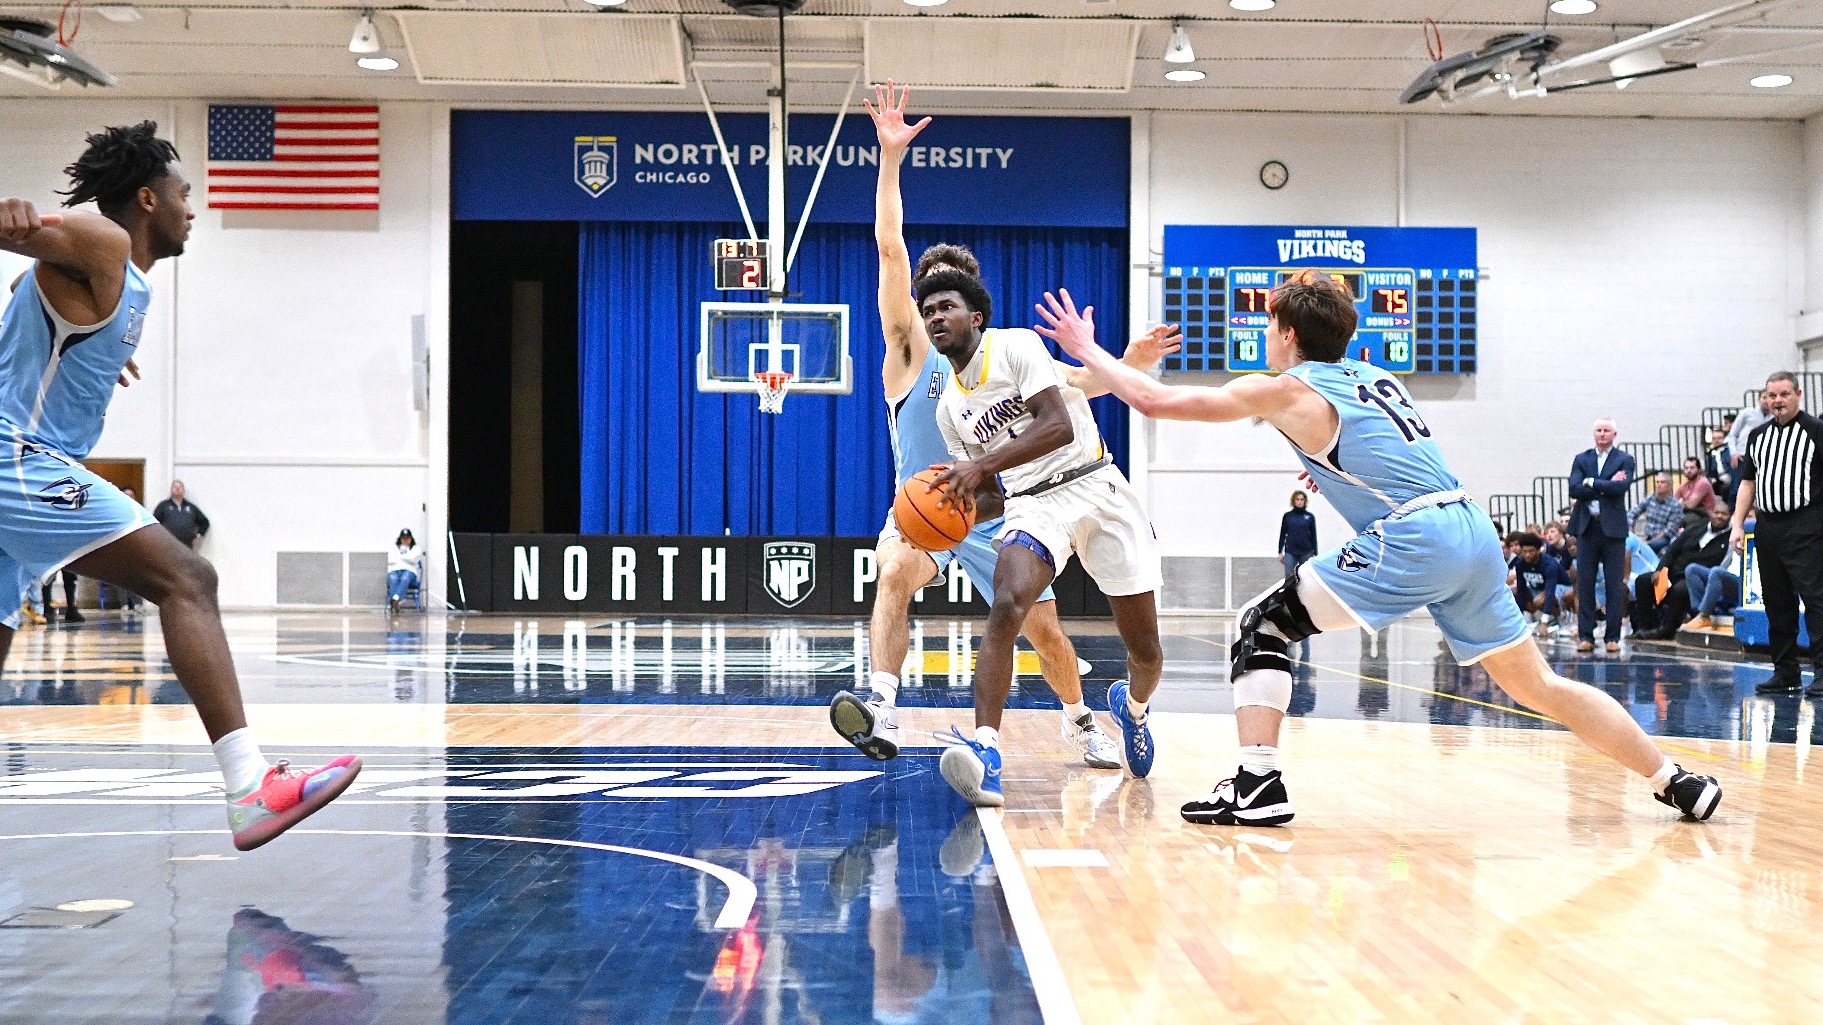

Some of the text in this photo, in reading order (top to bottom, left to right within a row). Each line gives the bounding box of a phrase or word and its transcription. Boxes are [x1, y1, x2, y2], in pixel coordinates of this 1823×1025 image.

[634, 143, 1015, 169] NORTH PRK UNERSITY
[634, 171, 711, 184] CHICAGO
[1294, 229, 1348, 239] NORTH PARK
[1277, 239, 1366, 264] VIKINGS
[742, 260, 760, 288] 2
[1192, 266, 1199, 277] F
[1208, 267, 1225, 277] PTS
[1235, 272, 1269, 284] HOME
[1442, 269, 1449, 279] F
[1458, 269, 1475, 279] PTS
[1367, 273, 1411, 286] VISITOR
[1240, 288, 1270, 312] 77
[1378, 289, 1408, 314] 75
[1247, 316, 1270, 326] BONU
[1366, 317, 1394, 327] BONUS
[1232, 331, 1259, 340] FOULS
[1383, 332, 1409, 341] FOULS
[1239, 340, 1258, 361] 10
[1389, 341, 1409, 362] 10
[1357, 378, 1431, 443] 13
[513, 545, 726, 602] NORTH
[769, 559, 810, 602] NP
